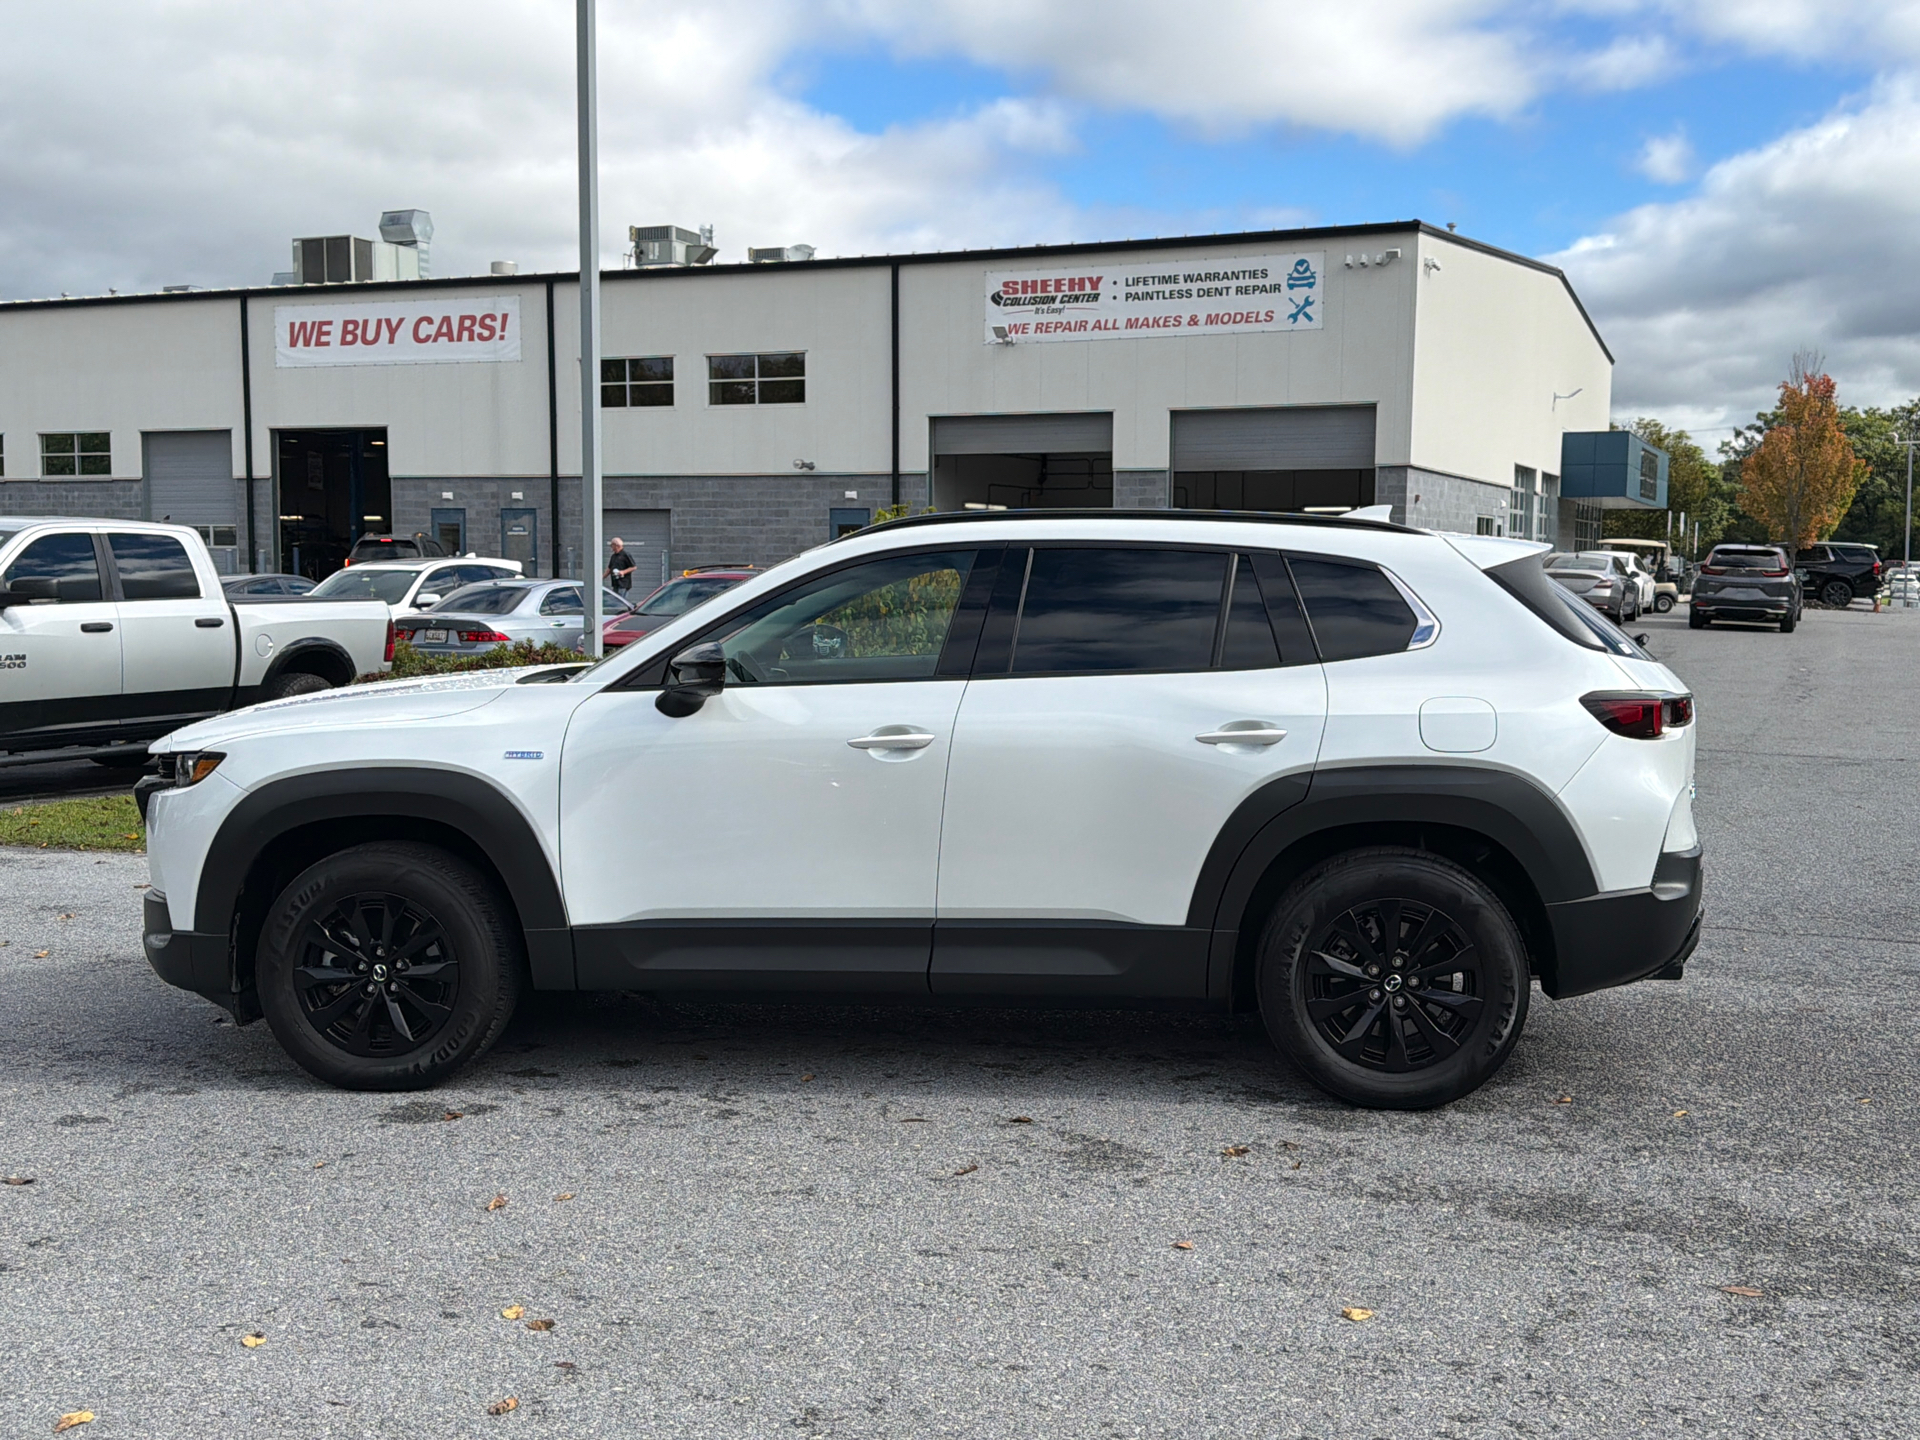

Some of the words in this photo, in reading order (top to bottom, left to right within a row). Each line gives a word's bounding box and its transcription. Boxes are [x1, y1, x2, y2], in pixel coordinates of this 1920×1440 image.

[1002, 275, 1104, 296] SHEEHY
[1125, 274, 1180, 287] LIFETIME
[1183, 268, 1269, 284] WARRANTIES
[1002, 295, 1056, 307] COLLISION
[1059, 292, 1101, 305] CENTER
[1125, 288, 1193, 302] PAINTLESS
[1197, 286, 1232, 298] DENT
[1235, 283, 1281, 296] REPAIR
[1034, 306, 1045, 315] It's
[1046, 305, 1066, 315] Easy!
[289, 320, 333, 348] WE
[340, 317, 405, 346] BUY
[412, 313, 509, 344] CARS!
[1007, 322, 1031, 335] WE
[1034, 319, 1089, 334] REPAIR
[1091, 318, 1120, 332] ALL
[1124, 314, 1183, 330] MAKES
[1187, 314, 1200, 327] &
[1204, 310, 1275, 326] MODELS
